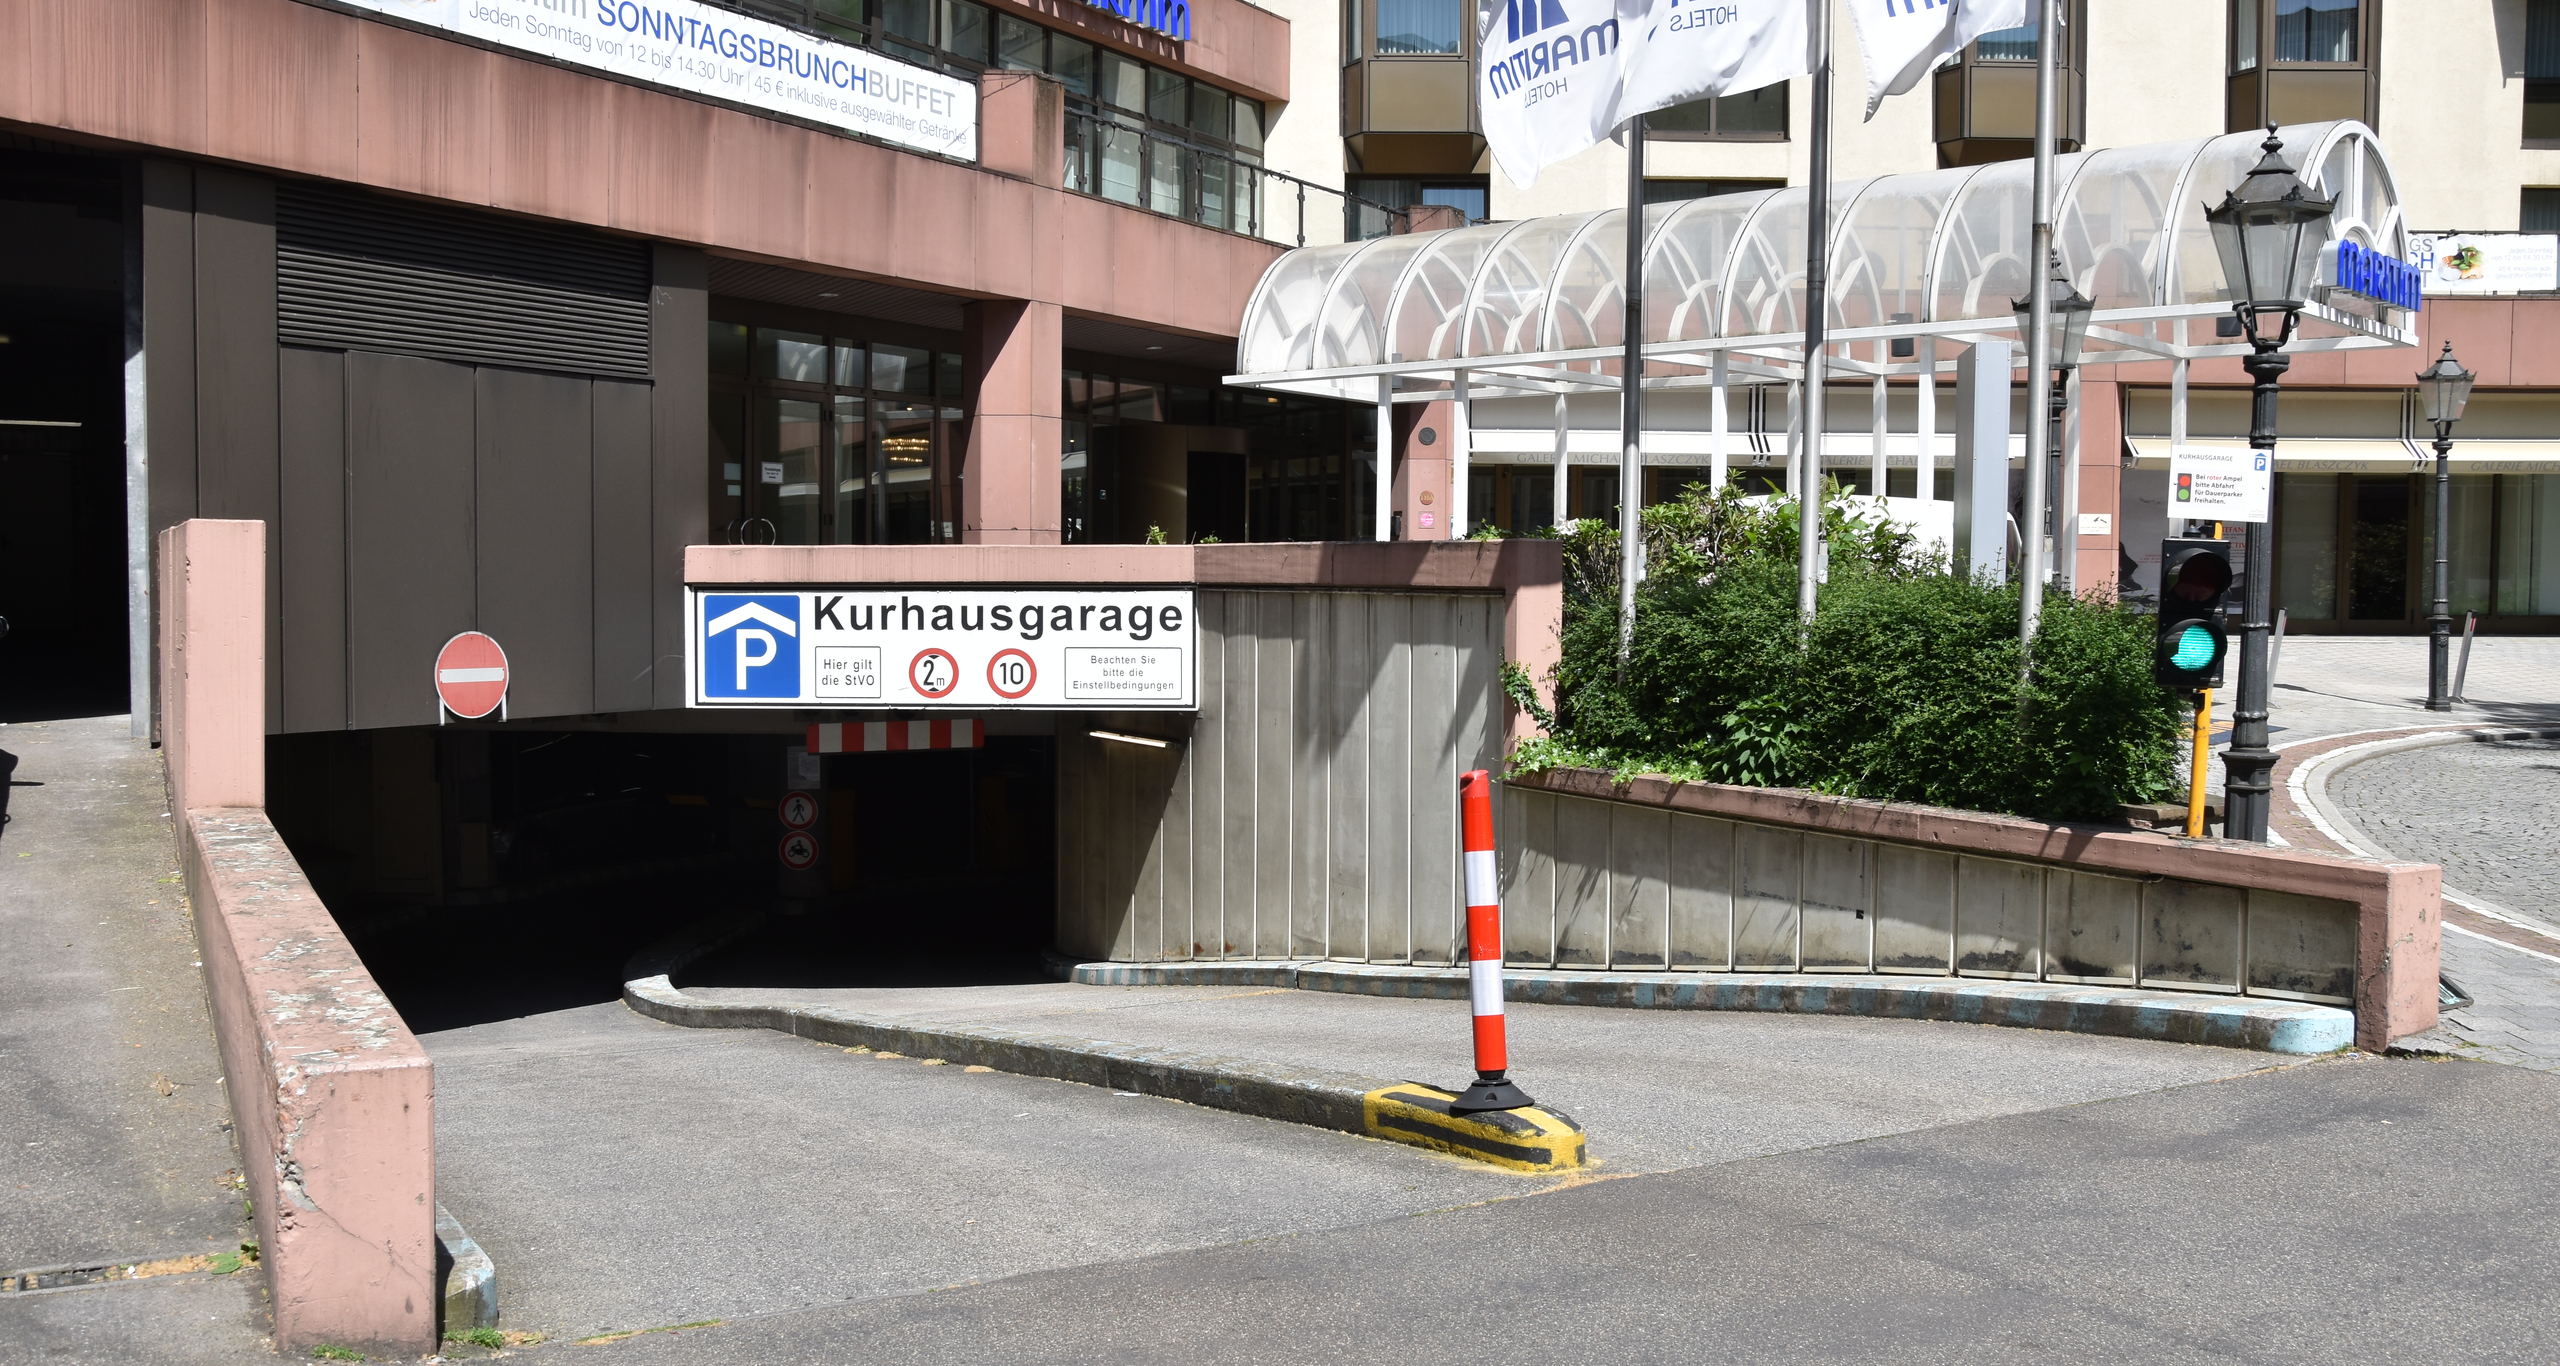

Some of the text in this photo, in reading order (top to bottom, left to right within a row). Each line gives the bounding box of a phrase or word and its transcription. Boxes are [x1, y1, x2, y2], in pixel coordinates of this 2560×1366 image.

[597, 0, 956, 118] SONNTAGSBRUNCHBUFFET
[469, 0, 520, 30] Jeden
[525, 15, 592, 52] Sonntag
[596, 38, 623, 57] von
[629, 43, 646, 63] 12
[652, 48, 672, 69] bis
[678, 55, 716, 80] 14.30
[719, 65, 744, 86] Uhr
[754, 75, 772, 94] 45
[786, 82, 838, 111] inklusive
[841, 101, 917, 131] ausgewählter
[918, 118, 967, 145] Getränke
[2527, 247, 2553, 255] Sonntag
[1516, 453, 1569, 463] GALER
[2178, 453, 2233, 462] KURHAUSGARAGE
[2205, 490, 2243, 498] Dauerparker
[2194, 497, 2226, 505] freihalten.
[814, 596, 1183, 641] Kurhausgarage
[735, 628, 777, 690] P
[1090, 655, 1156, 665] Beachten Sie
[823, 659, 873, 673] Hier gilt
[999, 662, 1024, 685] 10
[1102, 668, 1144, 677] bitte die
[821, 674, 875, 686] die StVO
[1072, 680, 1174, 692] Einstellbedingungen
